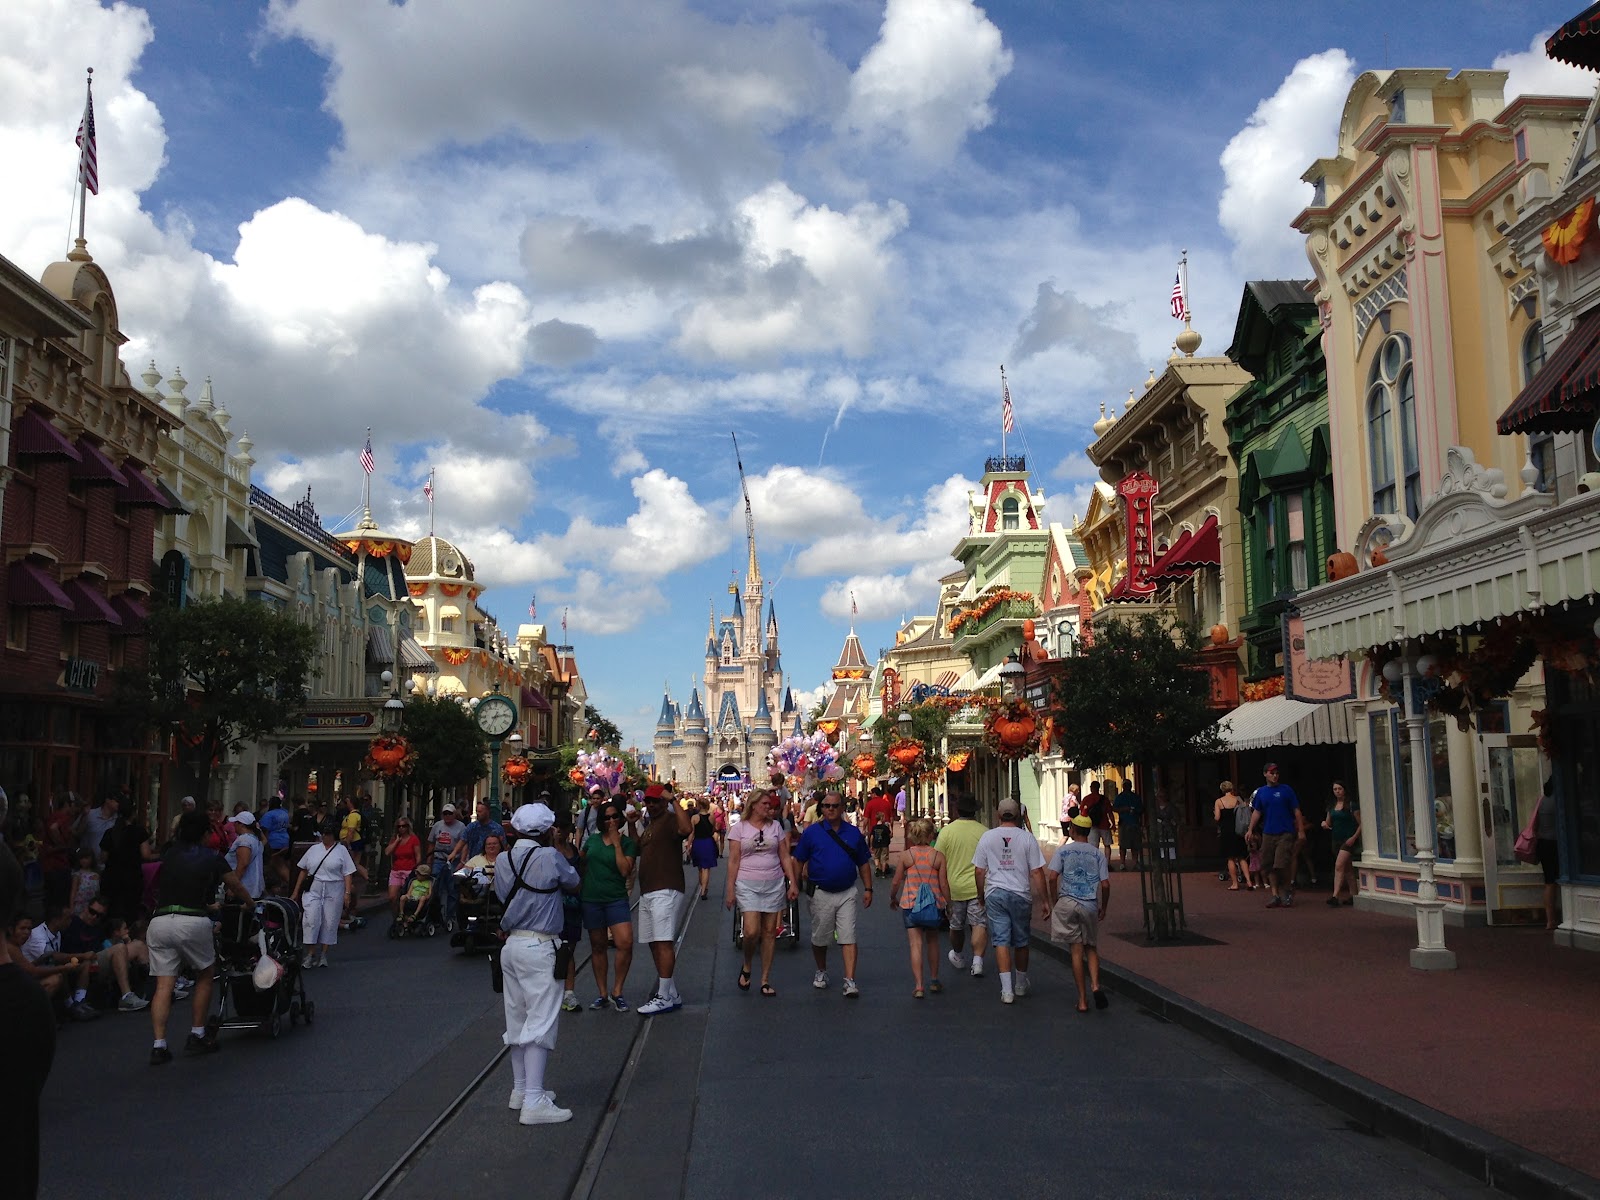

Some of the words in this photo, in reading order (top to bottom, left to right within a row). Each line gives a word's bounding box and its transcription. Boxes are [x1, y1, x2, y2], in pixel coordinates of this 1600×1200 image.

[1133, 497, 1150, 581] CINEMA
[70, 660, 99, 688] GIFTS
[317, 716, 351, 726] DOLLS
